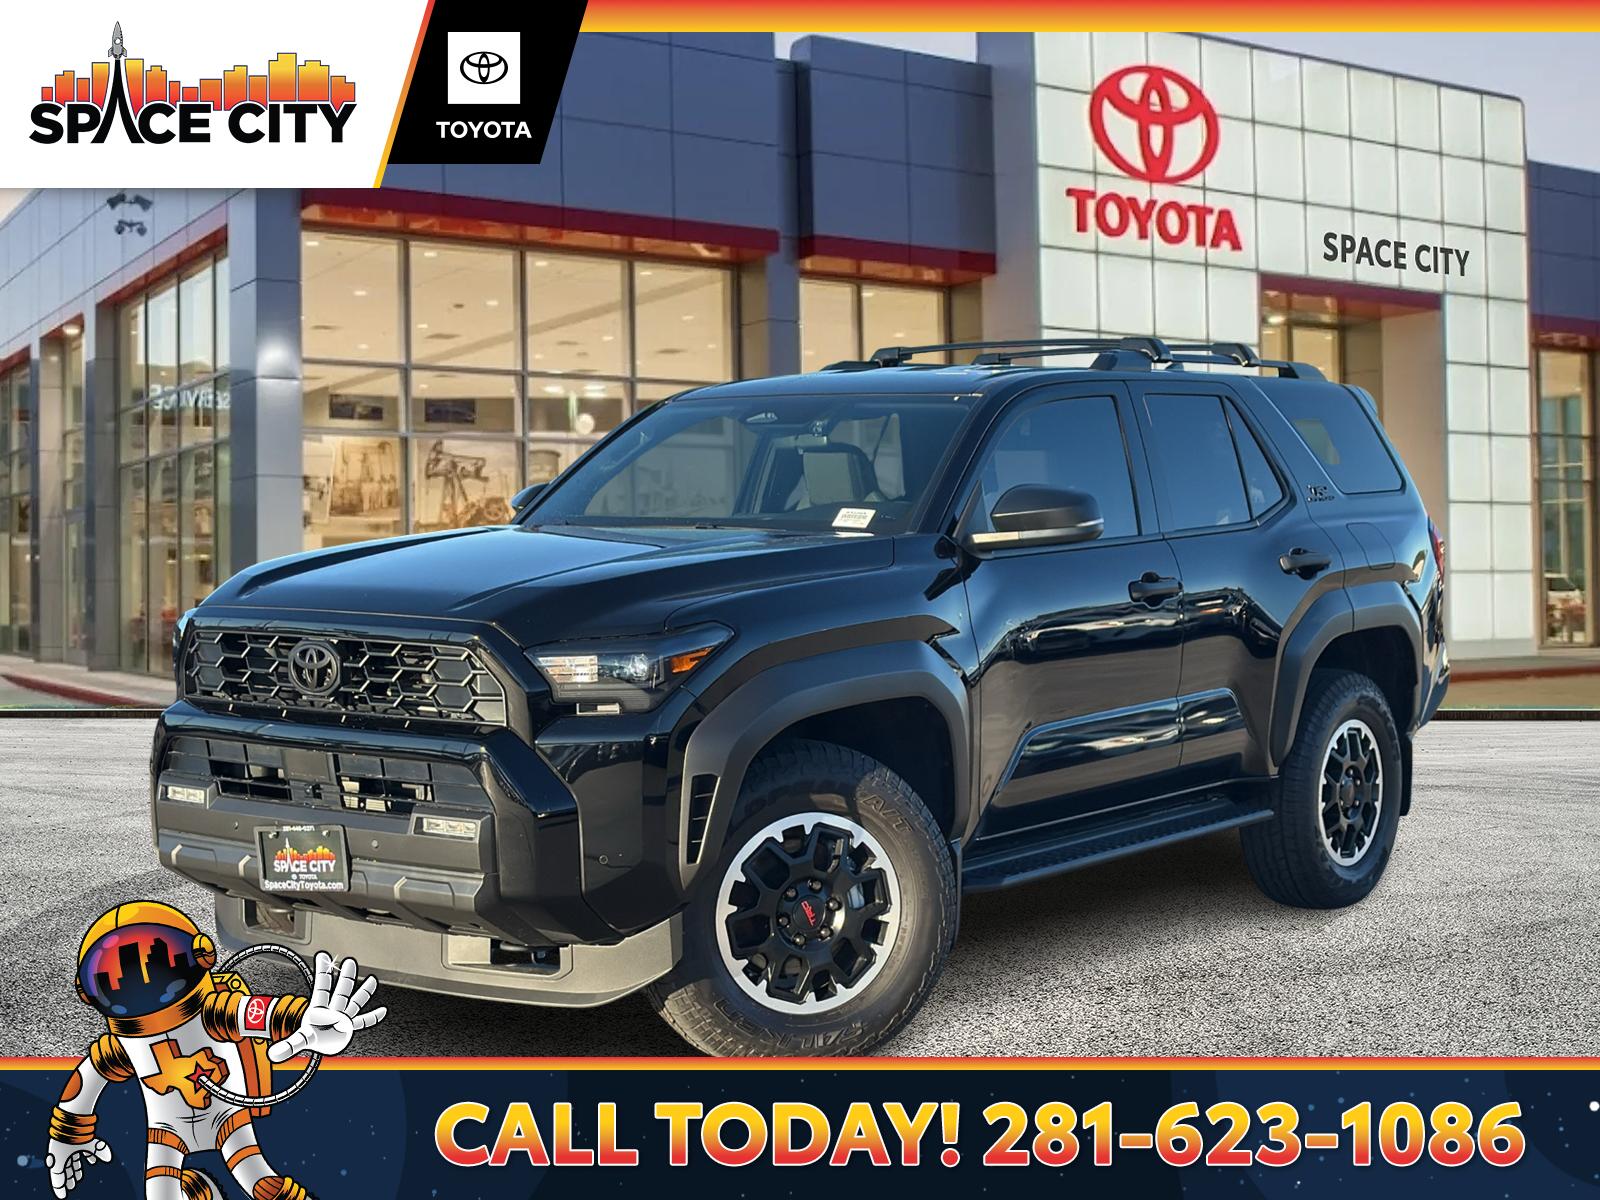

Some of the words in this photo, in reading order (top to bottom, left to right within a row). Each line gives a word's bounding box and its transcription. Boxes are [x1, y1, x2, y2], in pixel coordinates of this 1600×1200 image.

[1066, 187, 1243, 252] TOYOTA
[1323, 232, 1408, 271] SPACE
[1414, 244, 1471, 277] CITY
[273, 859, 307, 873] SPACE
[309, 859, 336, 873] CITY
[264, 880, 344, 891] SpaceCityToyota.com
